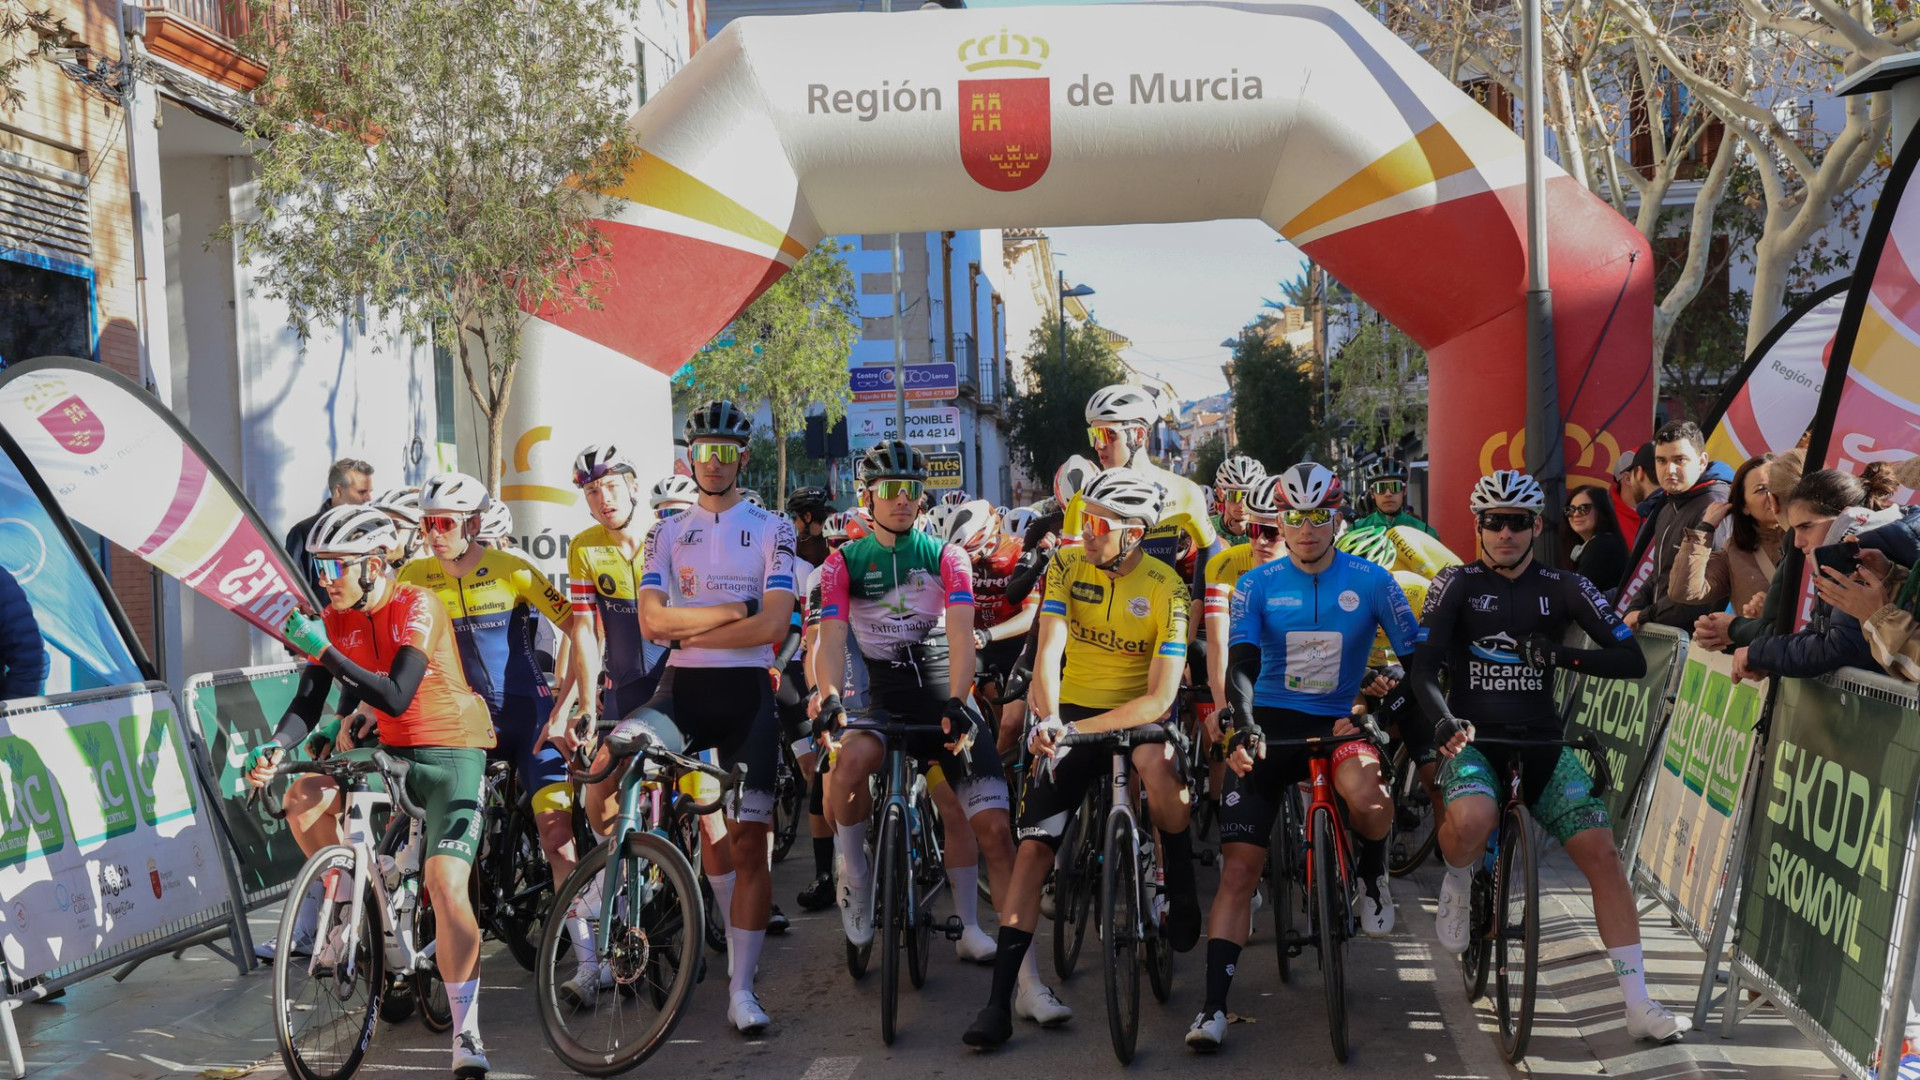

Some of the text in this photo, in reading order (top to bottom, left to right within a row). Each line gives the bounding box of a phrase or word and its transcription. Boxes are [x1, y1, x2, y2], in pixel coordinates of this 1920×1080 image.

[807, 68, 1263, 122] Región de Murcia
[1771, 359, 1814, 390] Región
[885, 414, 953, 427] DIPONIBLE
[909, 430, 924, 439] 44
[926, 428, 942, 438] 42
[943, 427, 956, 437] 14
[928, 457, 960, 471] rnés
[707, 574, 758, 583] Ayuntamiento
[706, 580, 758, 593] Cartagena
[468, 601, 506, 612] cladding
[543, 587, 570, 615] DPX
[454, 619, 507, 633] ompassion
[1070, 618, 1148, 654] Cricket
[1468, 660, 1544, 678] Ricardo
[1469, 676, 1543, 692] Fuentes
[1766, 841, 1862, 963] SKOMOVIL
